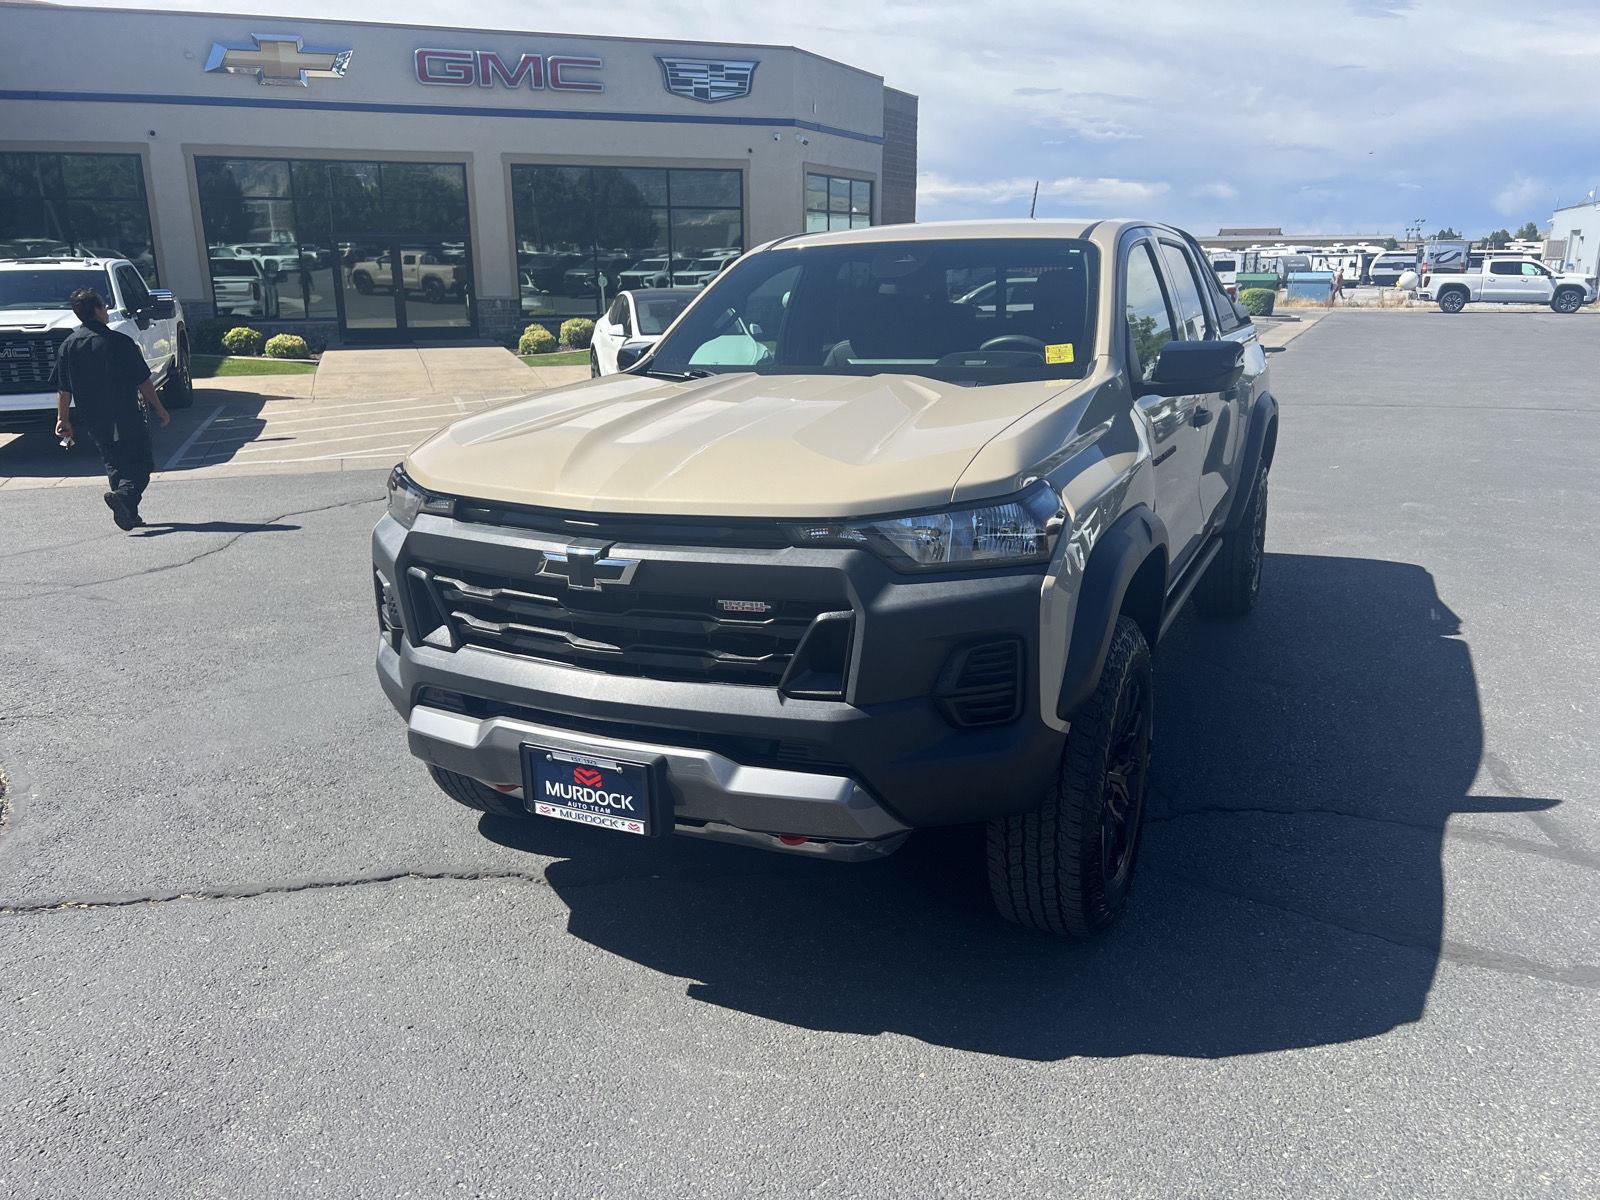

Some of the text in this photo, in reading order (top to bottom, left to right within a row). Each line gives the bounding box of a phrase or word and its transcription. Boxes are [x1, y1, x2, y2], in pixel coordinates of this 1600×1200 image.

[414, 47, 605, 92] GMC
[0, 346, 30, 358] MC
[545, 780, 635, 811] MURDOCK
[567, 801, 611, 814] AUTO TEAM
[559, 809, 621, 828] MURDOCK
